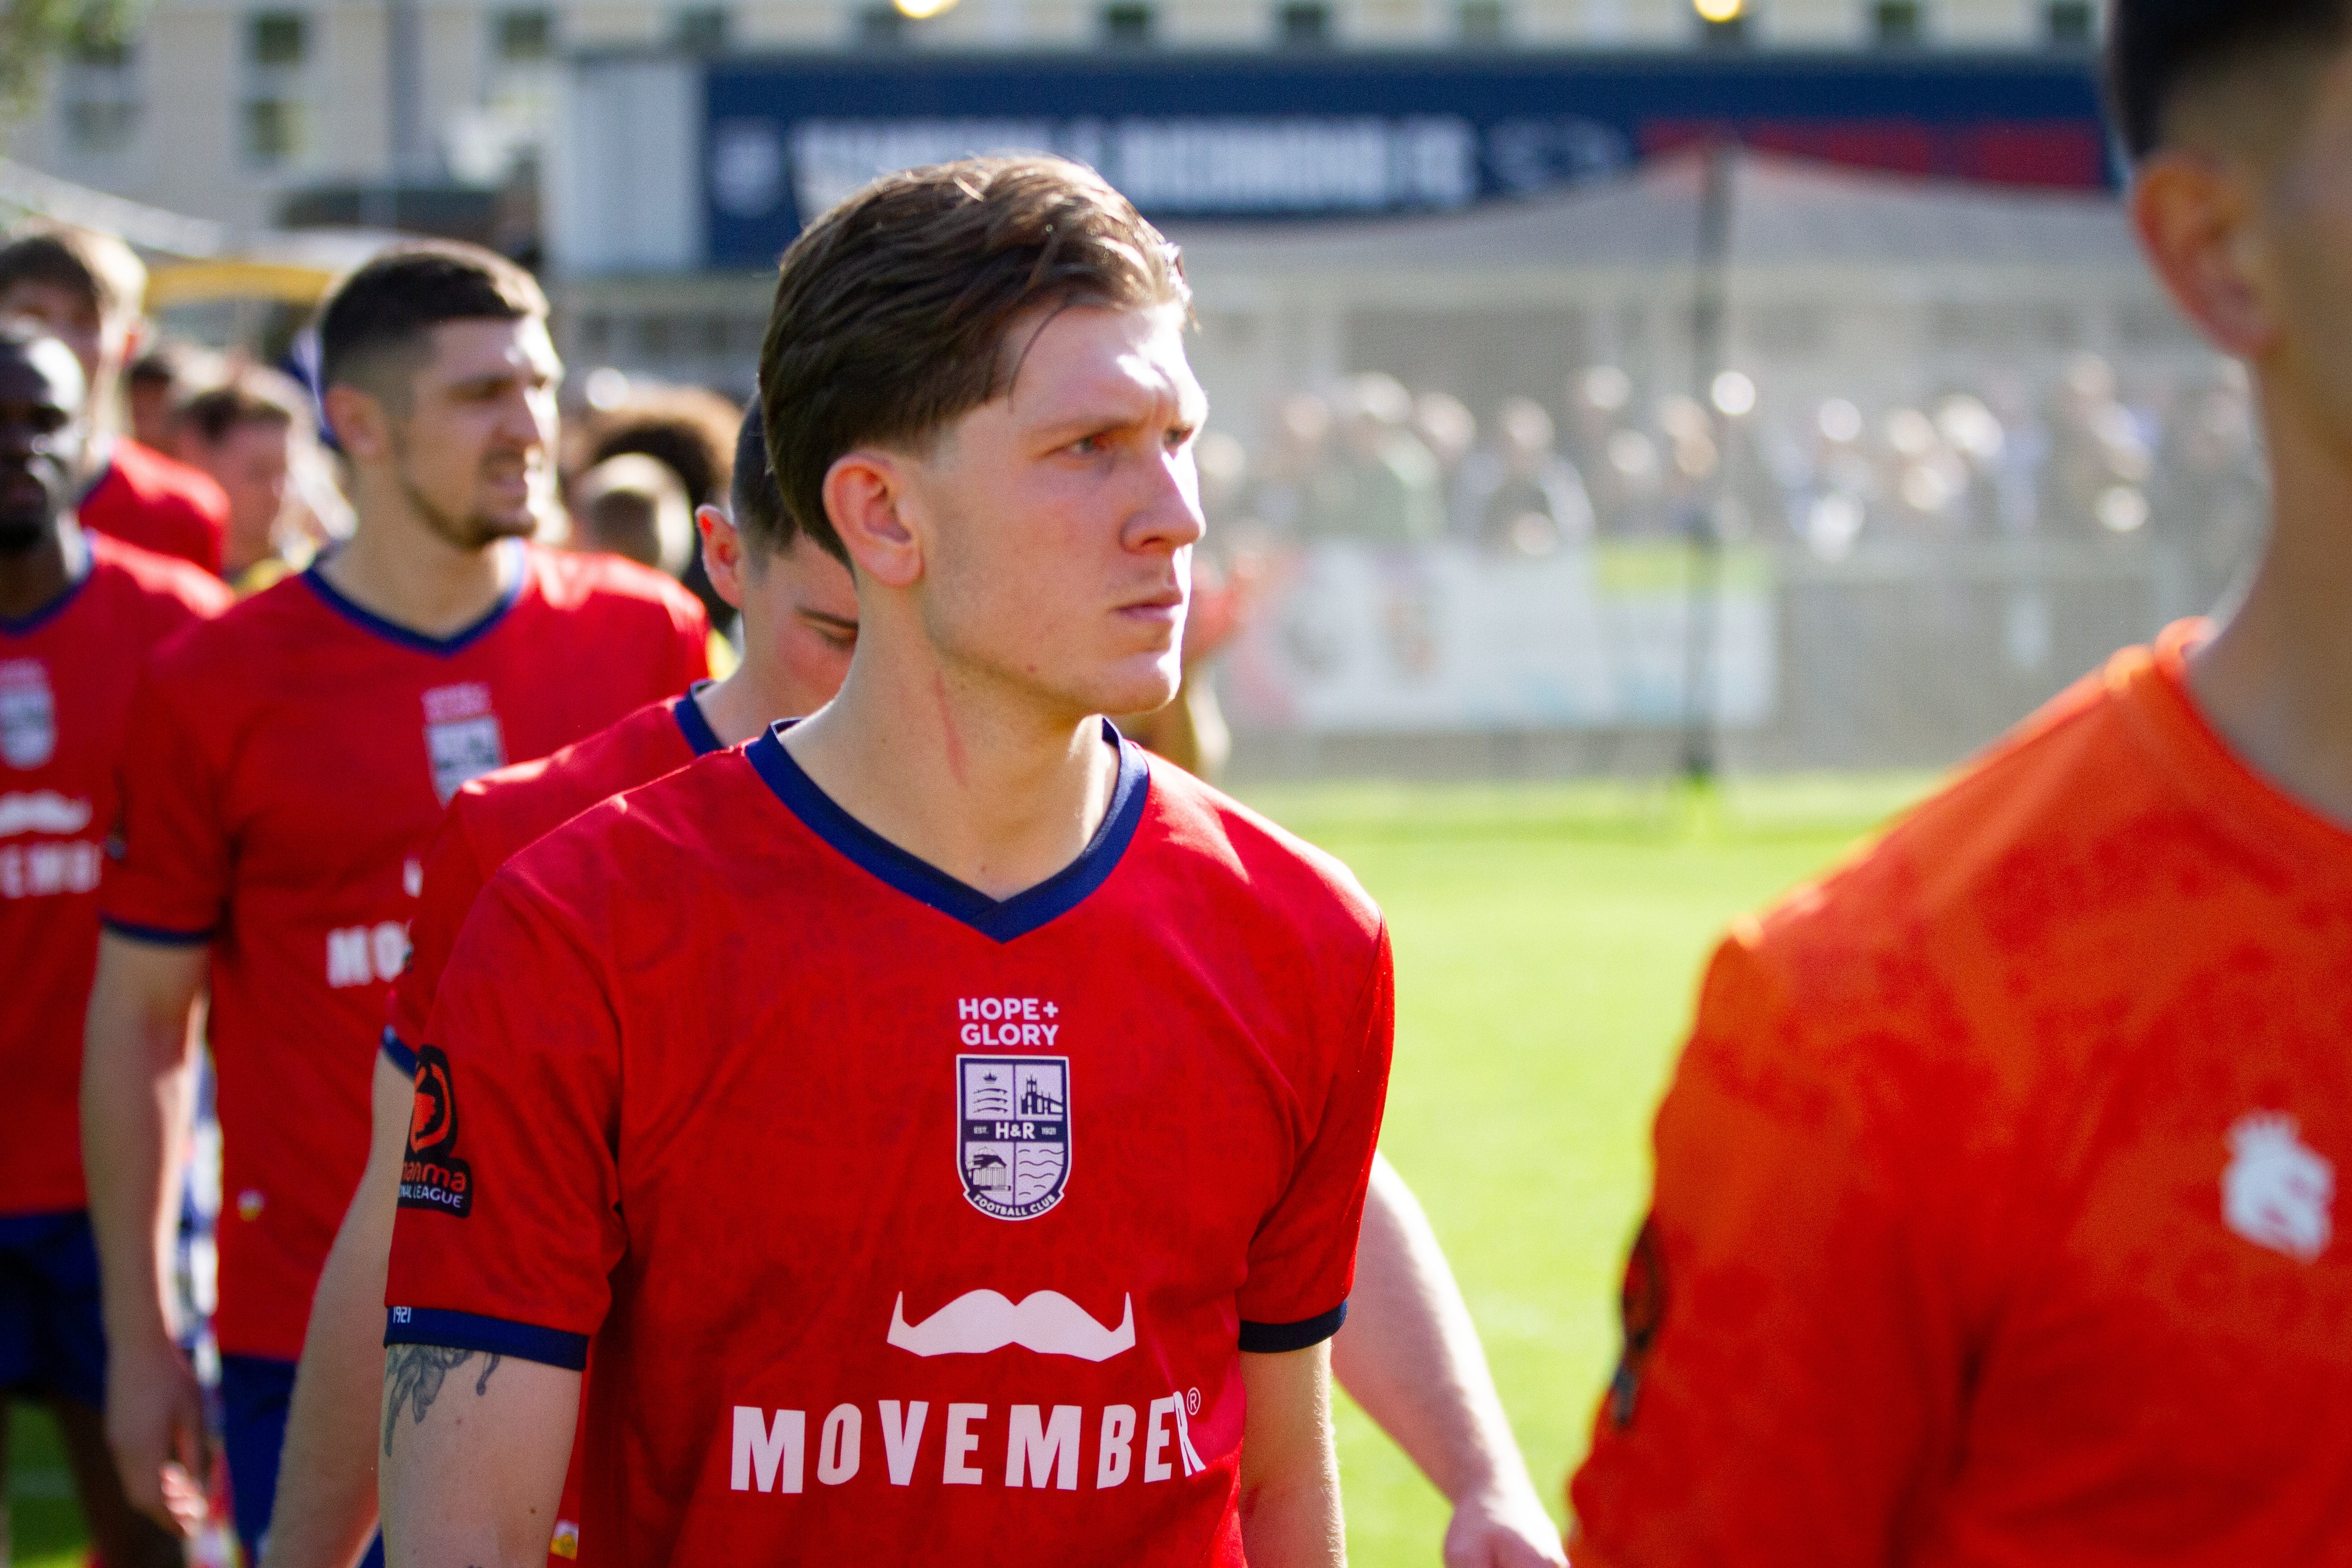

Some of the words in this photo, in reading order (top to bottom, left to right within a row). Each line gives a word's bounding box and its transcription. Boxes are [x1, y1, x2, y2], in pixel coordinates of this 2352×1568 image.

[960, 1023, 1059, 1046] GLORY
[995, 1121, 1035, 1139] H&R
[413, 1183, 463, 1208] LEAGUE
[973, 1194, 1028, 1216] FOOTBALL
[1030, 1194, 1056, 1213] CLUB
[393, 1306, 412, 1323] 1921
